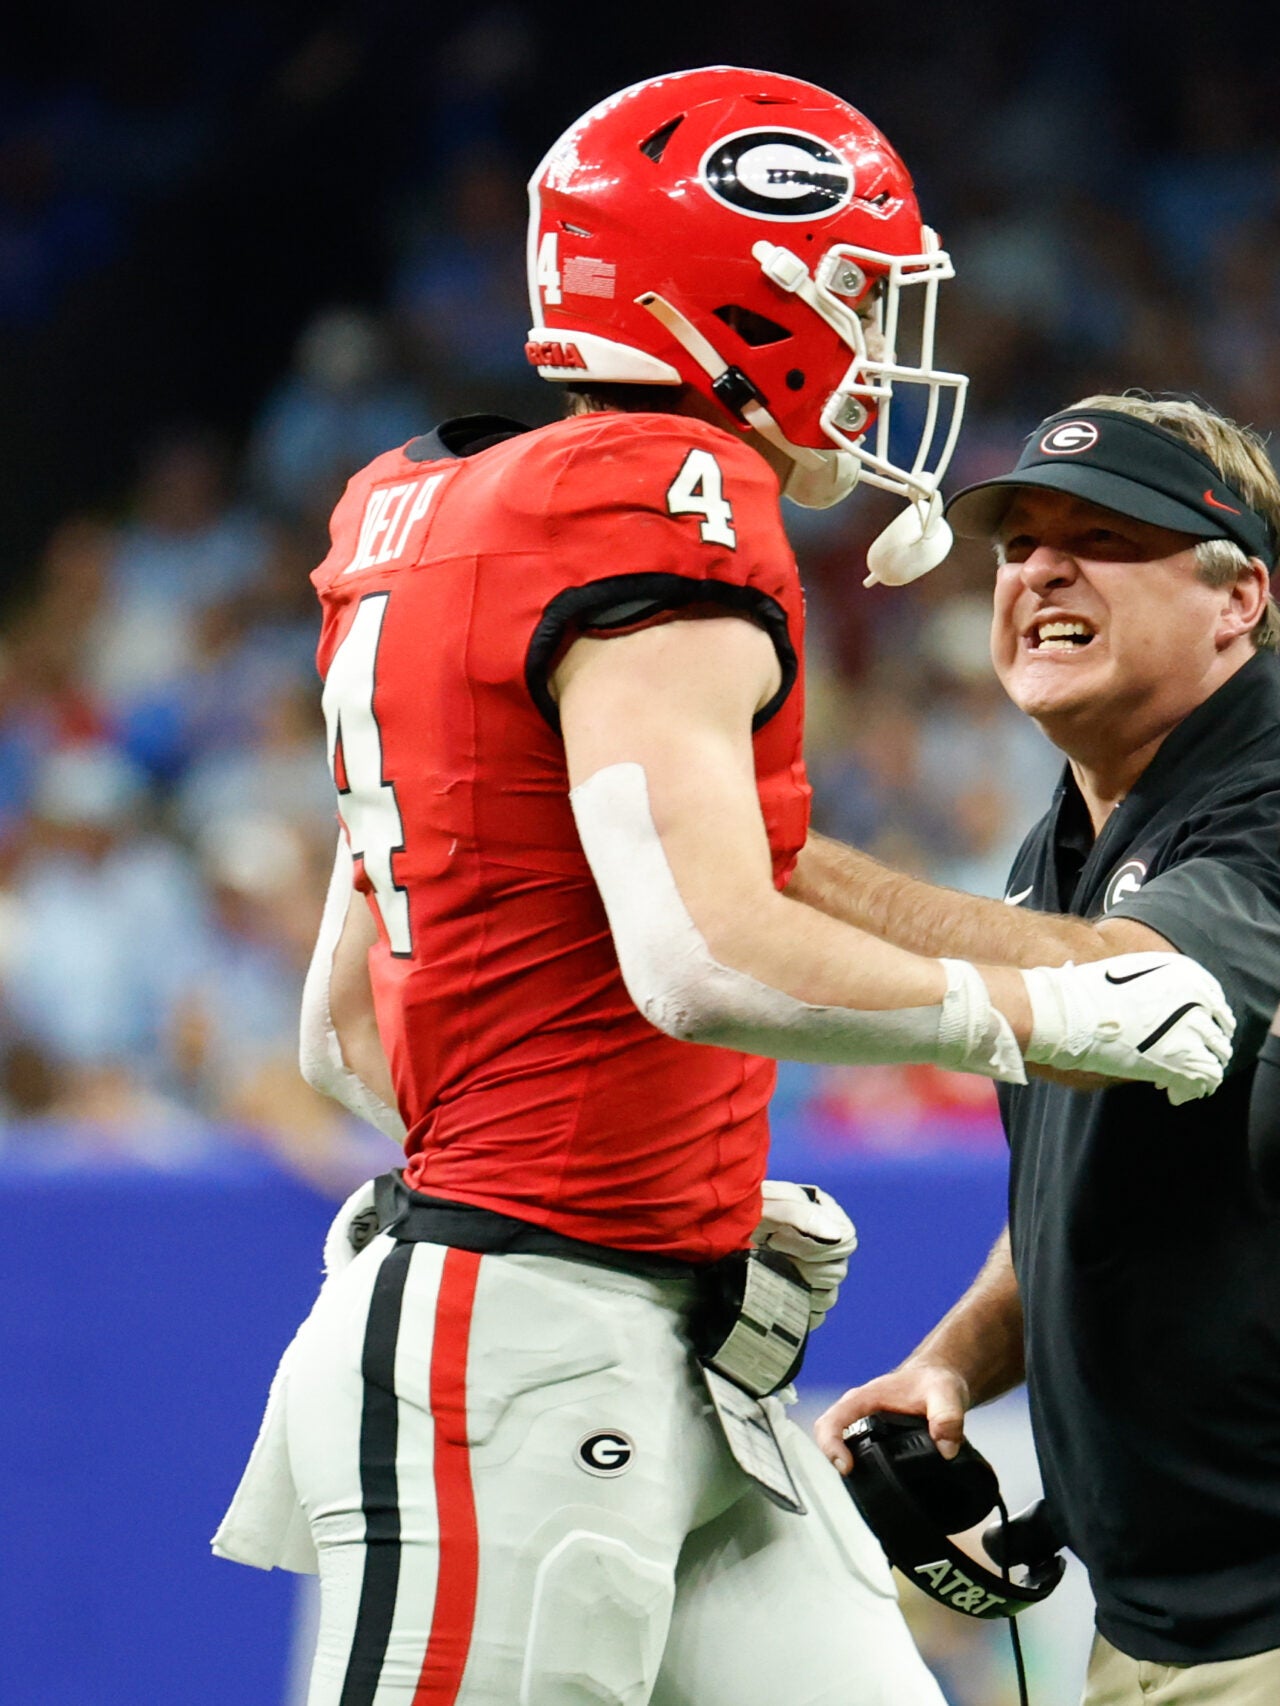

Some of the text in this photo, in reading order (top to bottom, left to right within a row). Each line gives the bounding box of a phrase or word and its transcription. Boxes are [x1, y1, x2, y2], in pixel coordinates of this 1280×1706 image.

[703, 130, 852, 217] G
[538, 232, 562, 304] 4
[1043, 424, 1097, 453] G
[343, 473, 445, 576] DELP
[667, 448, 736, 551] 4
[322, 590, 414, 960] 4
[578, 1430, 633, 1471] G
[914, 1558, 1006, 1615] AT&T
